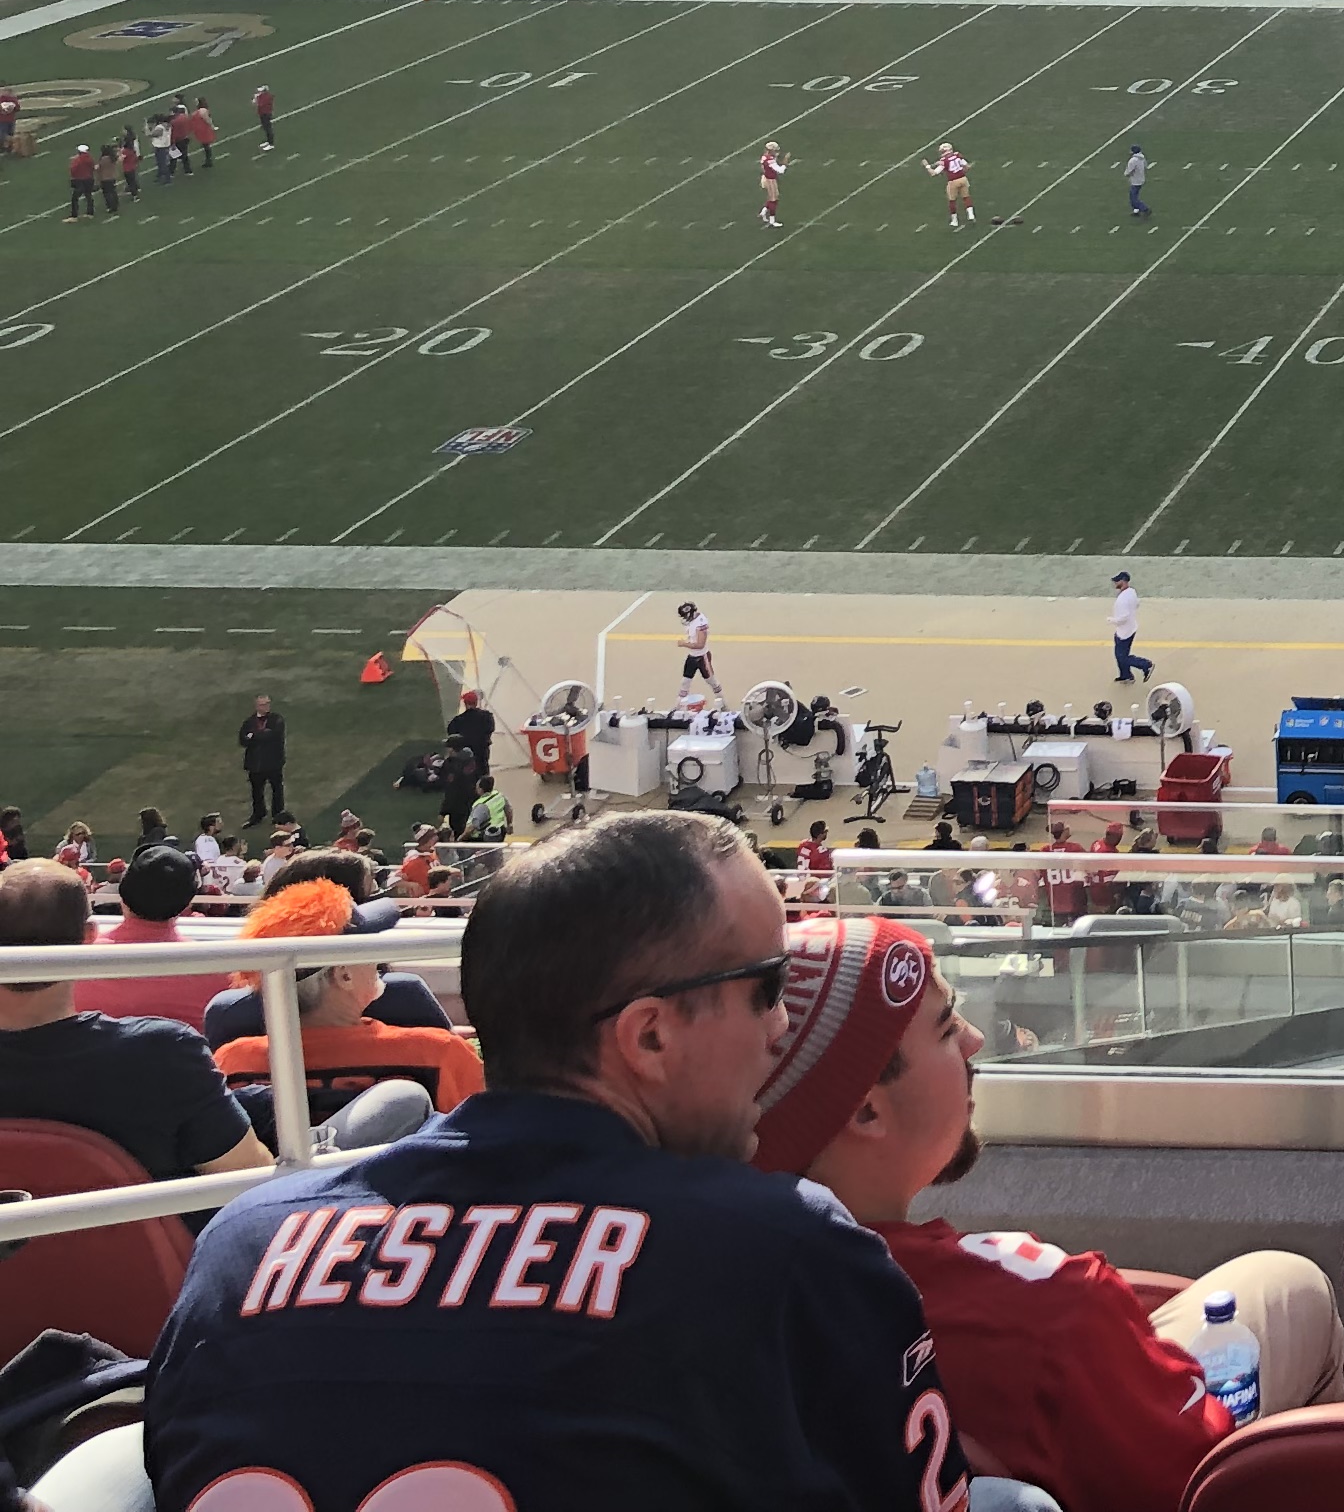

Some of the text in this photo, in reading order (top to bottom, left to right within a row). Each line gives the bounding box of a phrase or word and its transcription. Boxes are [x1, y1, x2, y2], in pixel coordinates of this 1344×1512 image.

[320, 326, 493, 356] 20
[767, 331, 925, 361] 30
[535, 738, 560, 763] G
[240, 1201, 651, 1319] HESTER
[905, 1388, 972, 1512] 2
